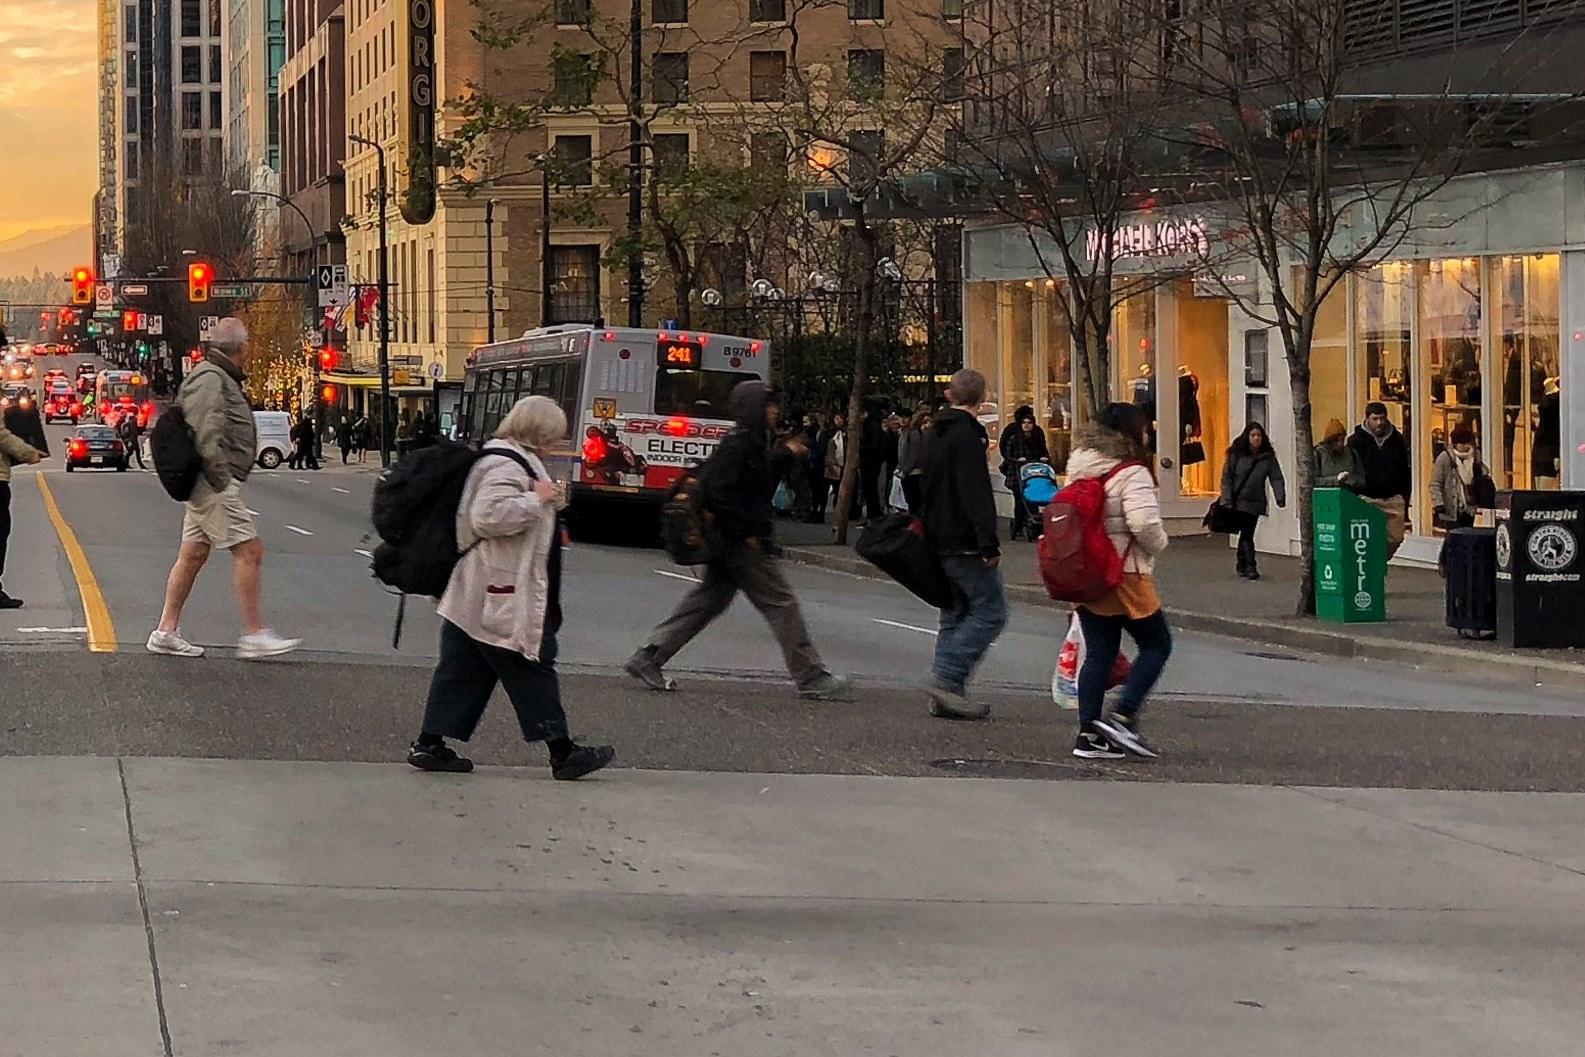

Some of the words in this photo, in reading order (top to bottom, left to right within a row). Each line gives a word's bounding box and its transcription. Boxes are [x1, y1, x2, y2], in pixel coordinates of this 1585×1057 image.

[667, 346, 691, 363] 241
[625, 418, 733, 440] SPEDER
[647, 438, 719, 456] ELECT
[646, 454, 682, 464] INDOOR
[1523, 508, 1579, 521] straight
